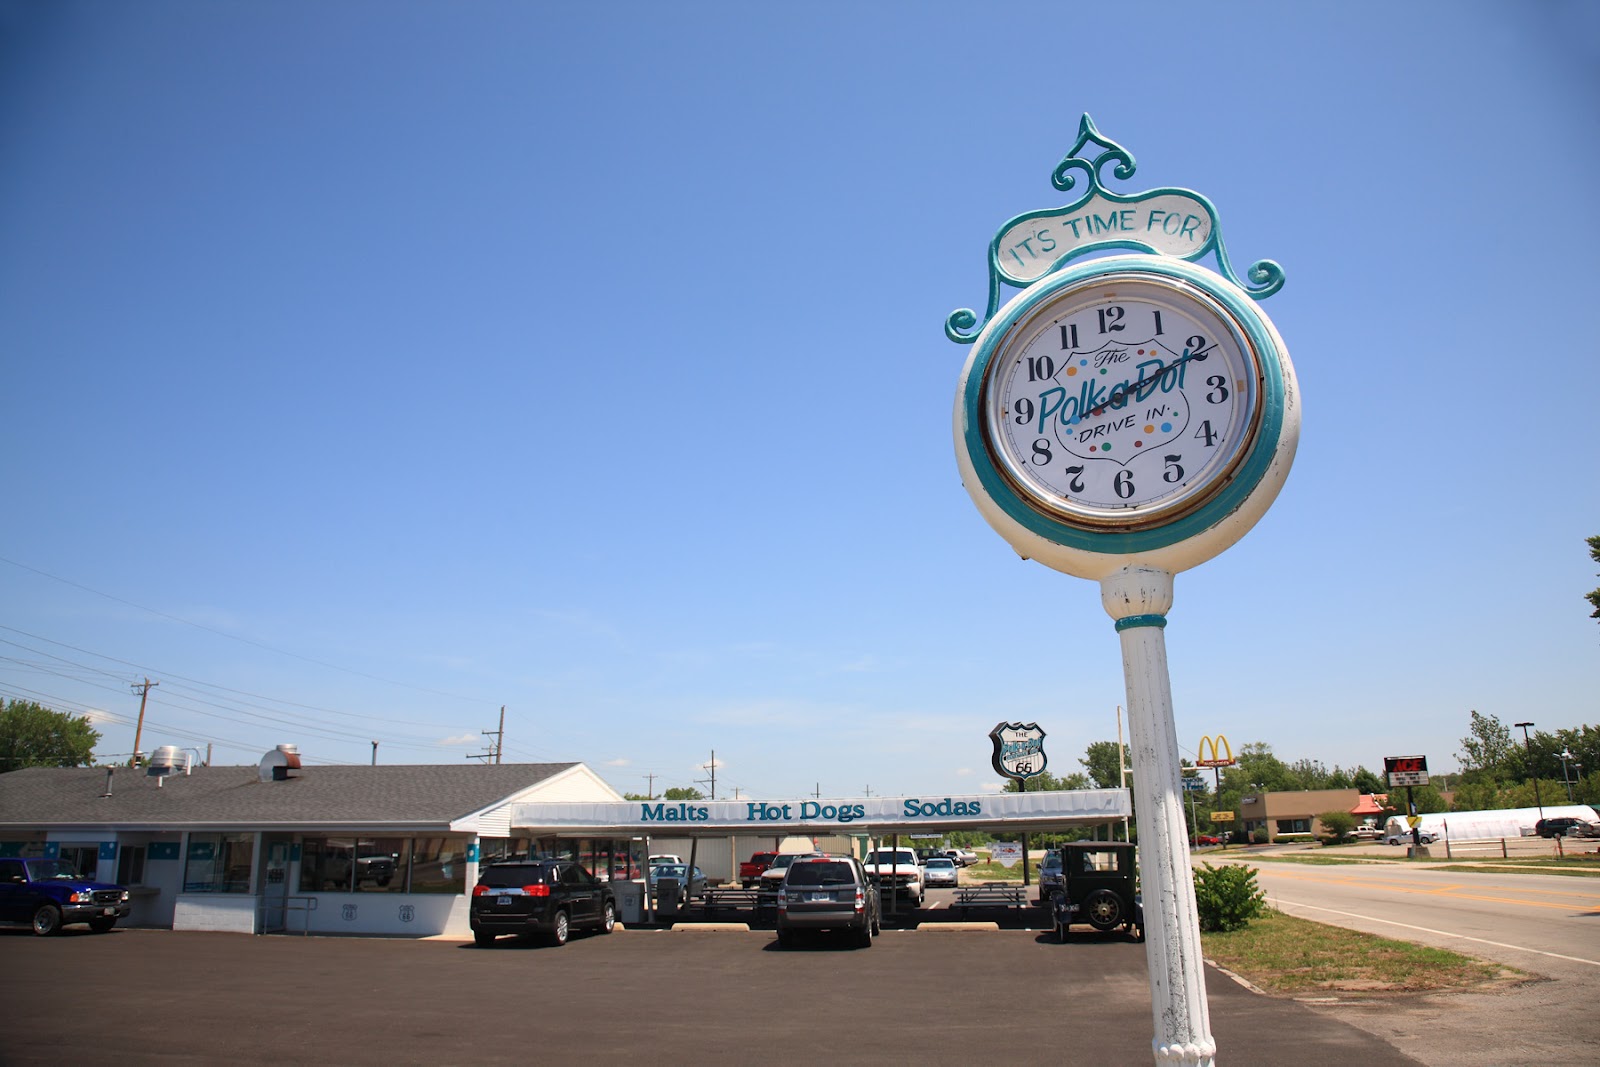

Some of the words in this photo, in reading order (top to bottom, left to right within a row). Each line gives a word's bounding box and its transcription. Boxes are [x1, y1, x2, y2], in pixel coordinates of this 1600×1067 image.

[1008, 229, 1057, 267] IT'S
[1062, 210, 1137, 239] TIME
[1147, 210, 1202, 242] FOR
[1096, 306, 1126, 335] 12
[1152, 310, 1165, 336] 1
[1059, 324, 1080, 350] 11
[1185, 335, 1209, 363] 2
[1026, 355, 1055, 383] 10
[1093, 348, 1131, 369] The
[1205, 375, 1229, 405] 3
[1014, 397, 1035, 426] 9
[1079, 414, 1136, 444] DRIVE
[1193, 419, 1218, 448] 4
[1031, 438, 1053, 467] 8
[1065, 464, 1085, 493] 7
[1163, 454, 1185, 483] 5
[1113, 469, 1136, 499] 6
[1015, 762, 1032, 774] 66
[1393, 759, 1423, 773] ACE
[641, 803, 709, 821] Malts
[746, 802, 792, 821] Hot
[800, 801, 865, 823] Dogs
[903, 798, 981, 817] Sodas
